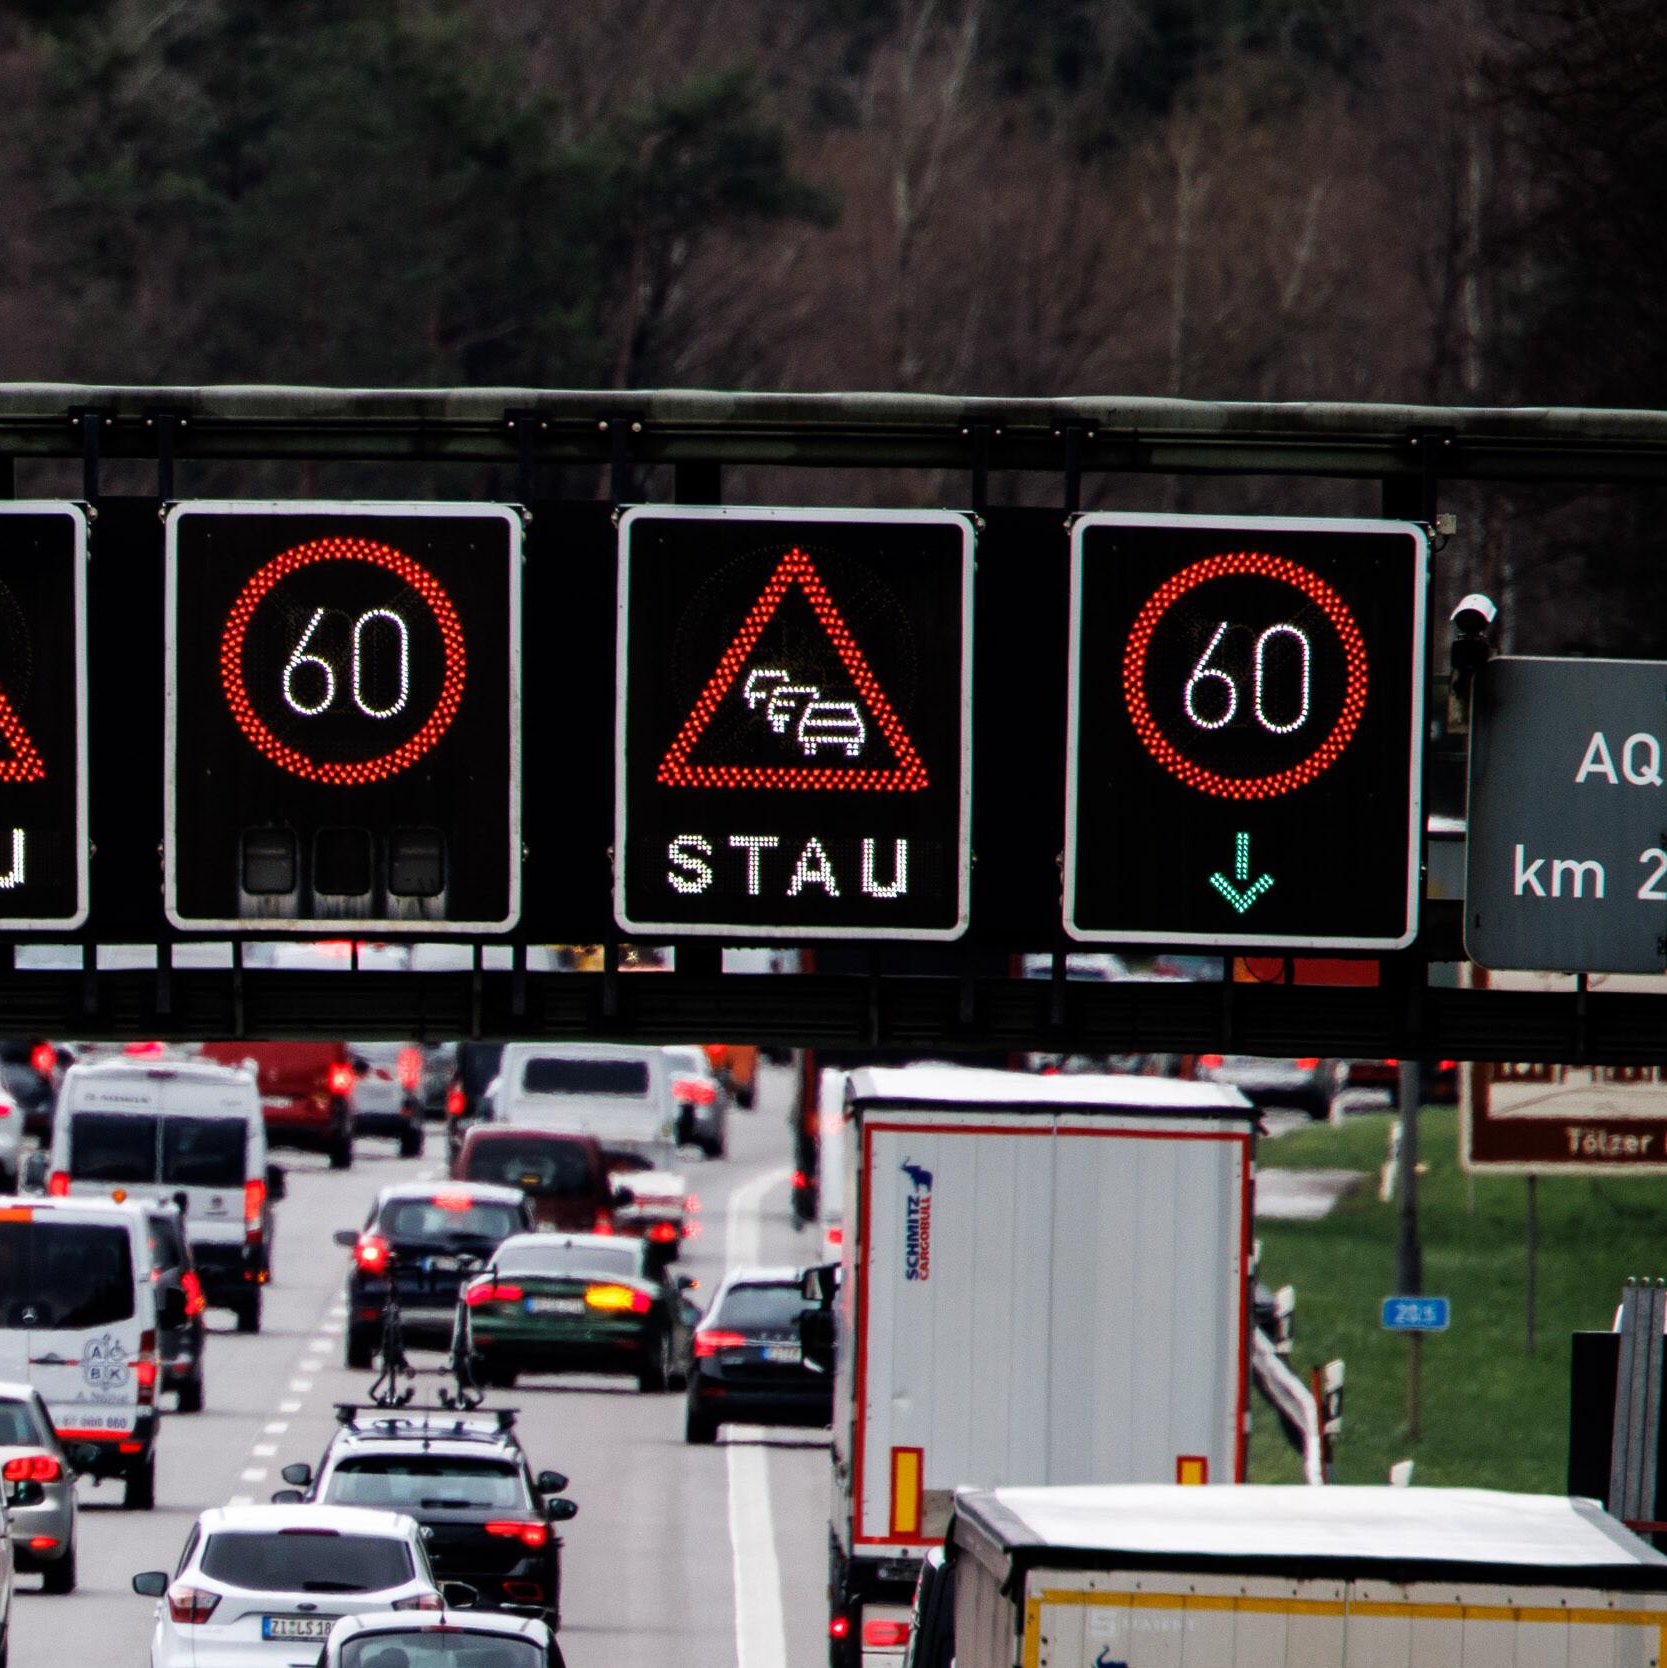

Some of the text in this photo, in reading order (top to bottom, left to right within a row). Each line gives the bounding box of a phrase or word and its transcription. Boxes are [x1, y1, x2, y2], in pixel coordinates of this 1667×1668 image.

[283, 608, 409, 718] 60
[1185, 622, 1310, 734] 60
[1574, 731, 1664, 787] AQ
[668, 835, 907, 898] STAU
[1513, 843, 1606, 899] km
[1568, 1127, 1654, 1156] Tölzer
[906, 1194, 920, 1281] SCHMITZ
[919, 1196, 932, 1282] CARGOBULL
